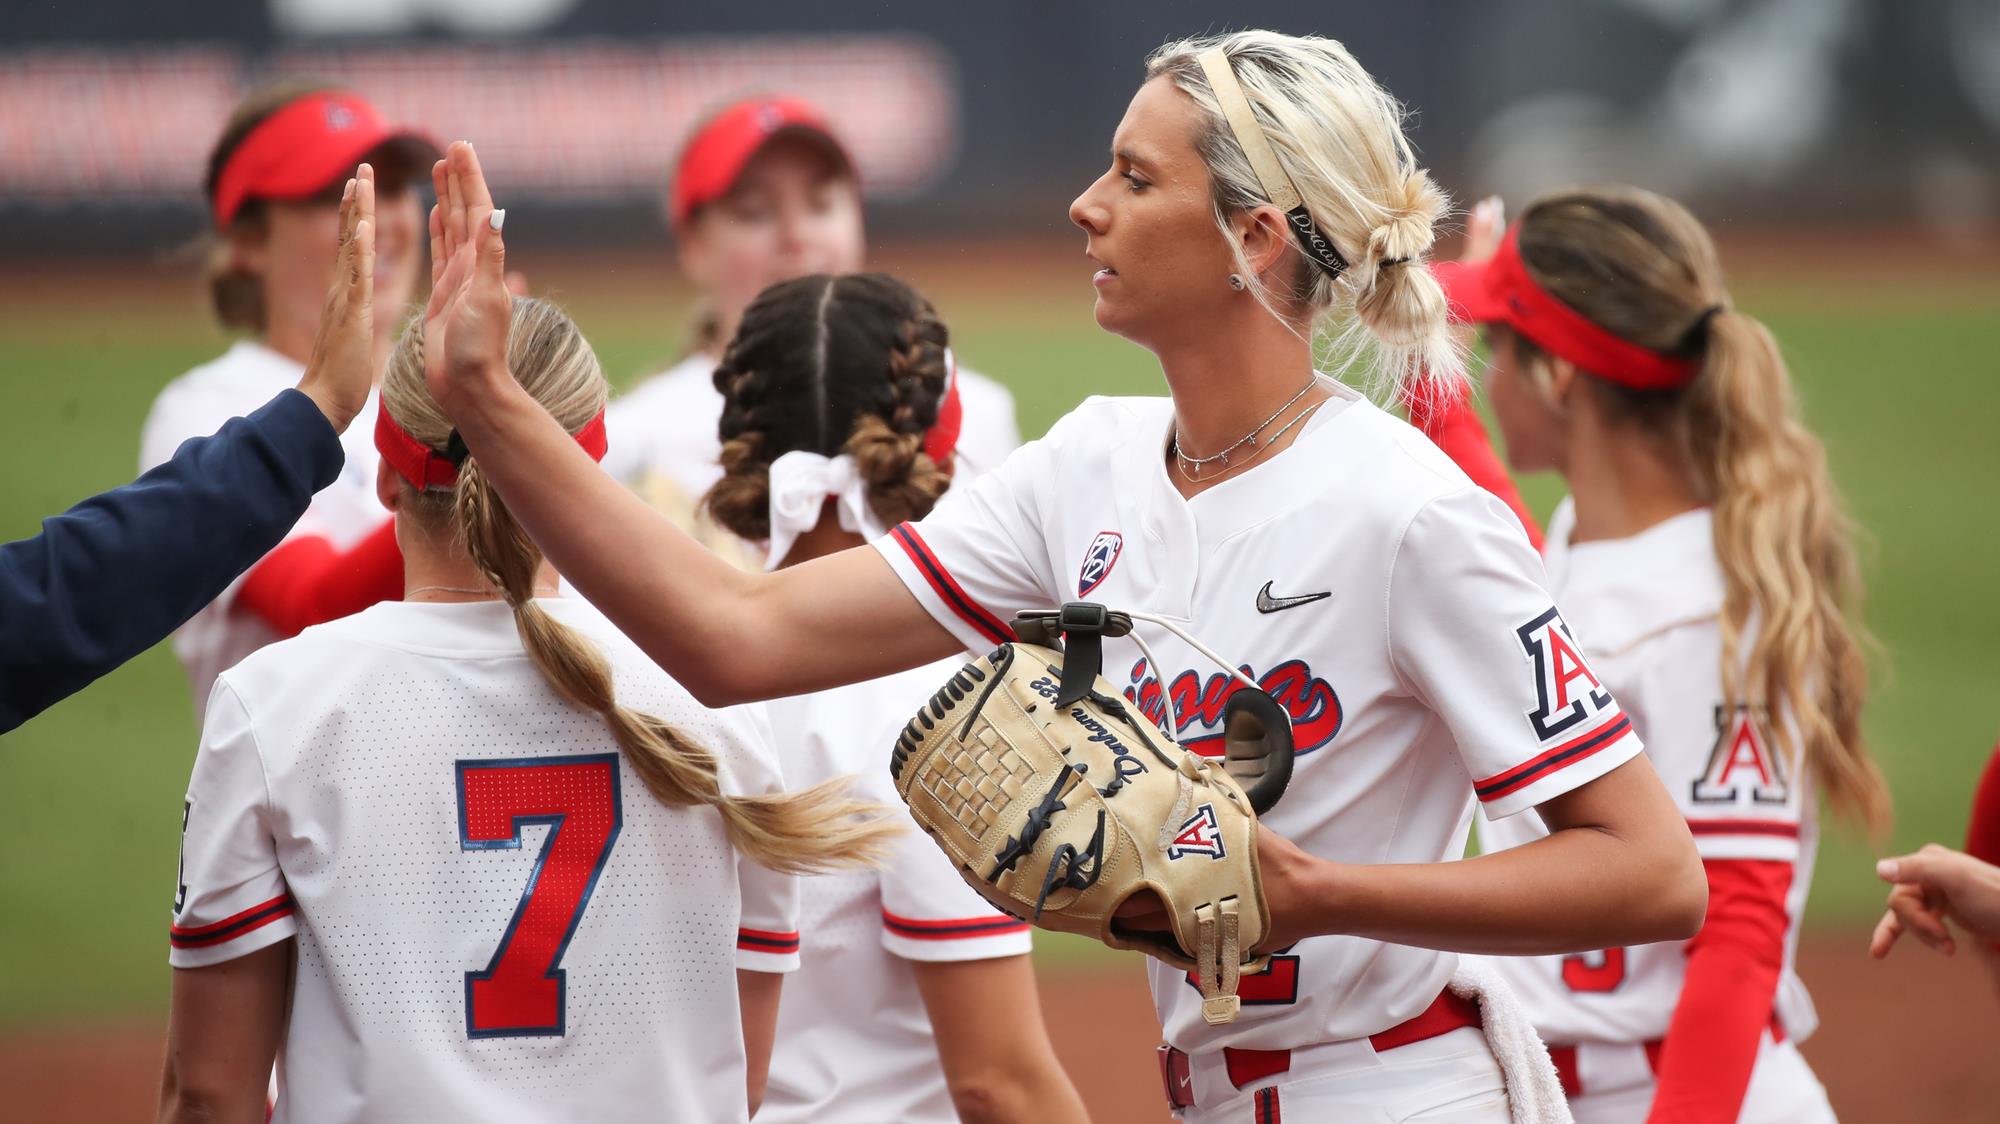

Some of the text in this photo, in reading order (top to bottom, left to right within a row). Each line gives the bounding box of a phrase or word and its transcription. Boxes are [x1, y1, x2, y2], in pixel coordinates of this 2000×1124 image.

[1515, 605, 1614, 743] A
[1072, 707, 1150, 785] Denham
[1692, 704, 1788, 804] A
[1167, 803, 1227, 861] A
[455, 752, 624, 1040] 7
